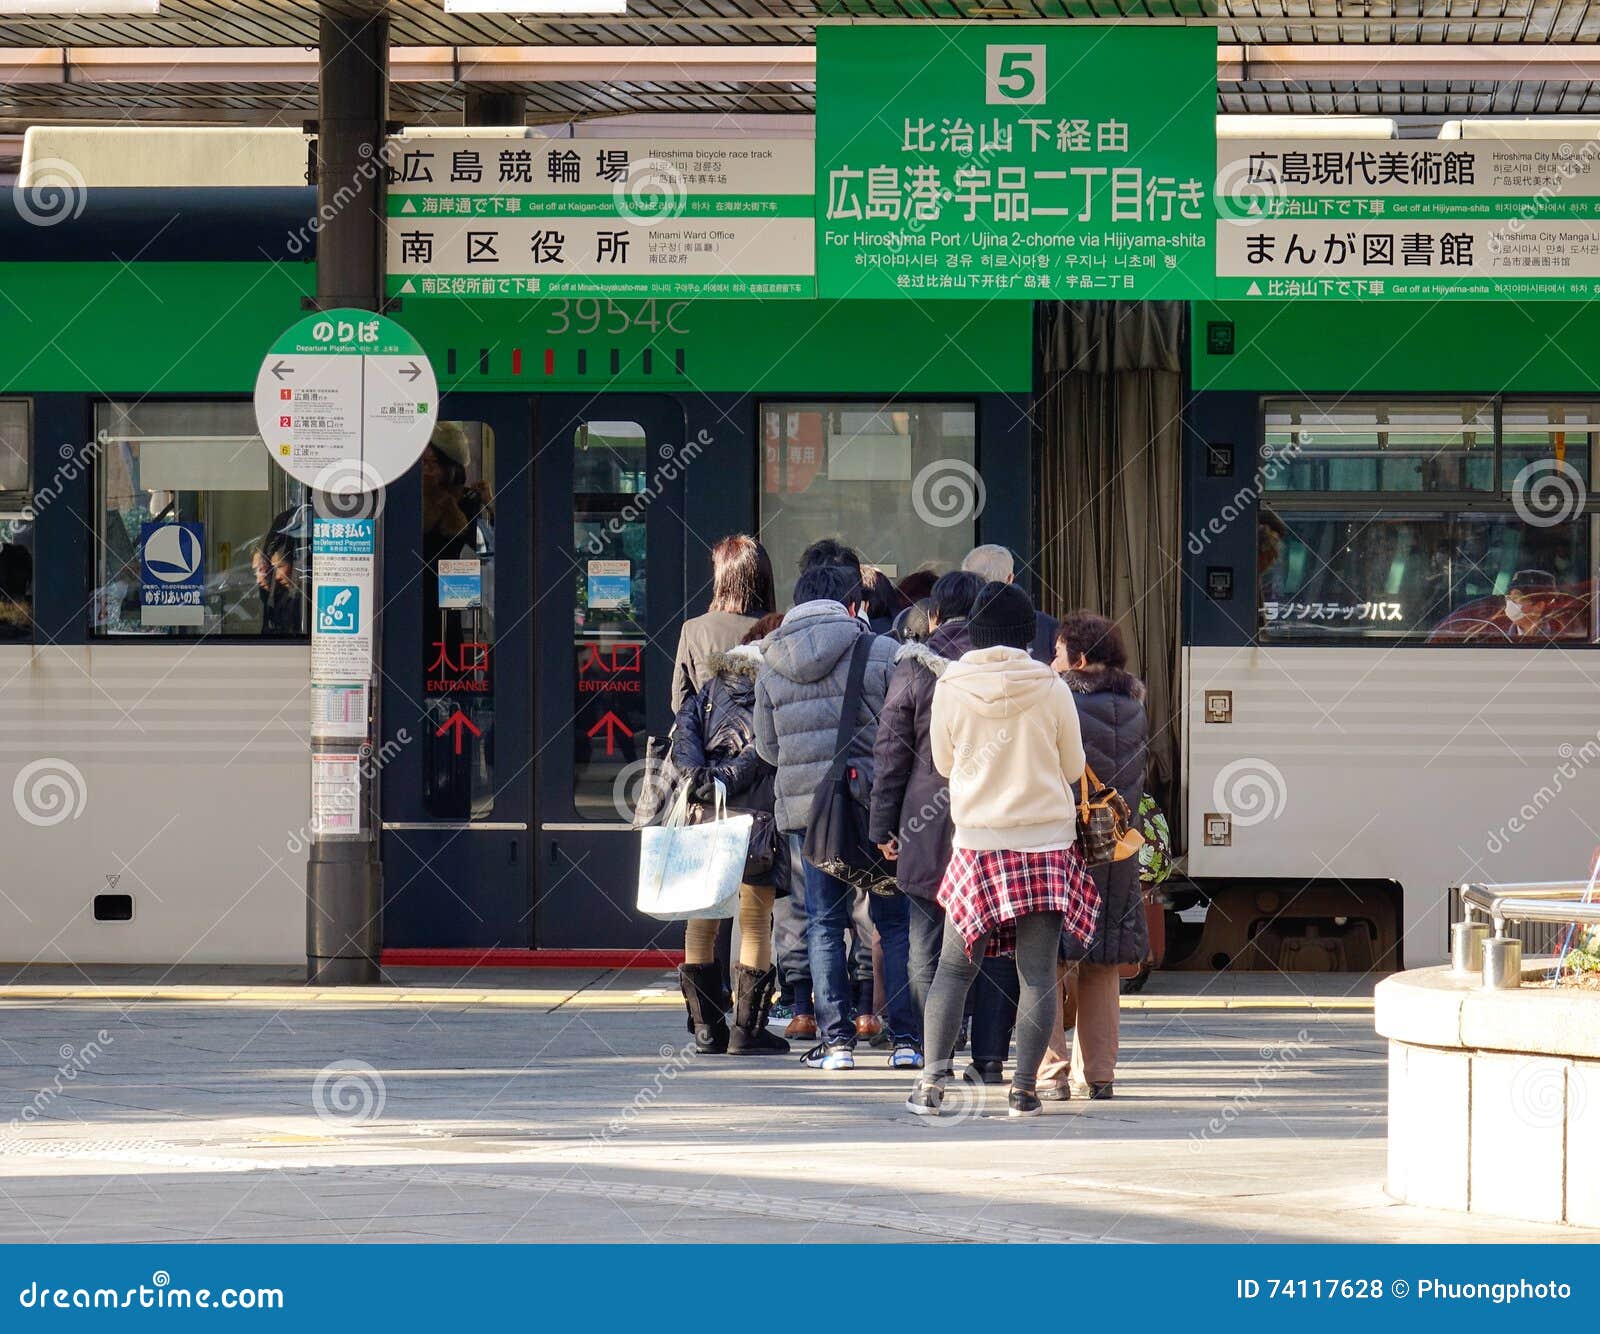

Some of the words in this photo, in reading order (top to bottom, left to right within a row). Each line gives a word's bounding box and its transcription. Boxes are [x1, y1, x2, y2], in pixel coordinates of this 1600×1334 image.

[997, 52, 1035, 99] 5
[902, 117, 1129, 153] 比治山下経由
[648, 150, 693, 159] Hiroshima
[695, 150, 726, 160] bicycle
[729, 151, 748, 159] race
[750, 150, 773, 159] track
[1492, 152, 1533, 161] Hiroshima
[1534, 152, 1550, 163] City
[401, 149, 630, 184] 広島競輪場
[1247, 151, 1475, 185] 広島現代美術館
[422, 197, 521, 214] 海岸通で下車
[528, 202, 544, 211] Get
[546, 202, 557, 211] off
[558, 203, 566, 211] at
[1268, 199, 1385, 216] 比治山下で下車
[1392, 203, 1409, 213] Get
[1410, 203, 1420, 213] off
[1422, 204, 1430, 213] at
[1432, 203, 1490, 215] Hijiyama-shita
[648, 231, 681, 240] Minami
[683, 231, 707, 240] Ward
[709, 231, 735, 240] Office
[825, 231, 849, 246] For
[853, 231, 926, 246] Hiroshima
[931, 231, 961, 246] Port
[971, 231, 1008, 249] Ujina
[1012, 231, 1075, 247] 2-chome
[1079, 232, 1100, 247] via
[1104, 231, 1206, 250] Hijiyama-shita
[1540, 232, 1558, 244] City
[1560, 232, 1589, 244] Manga
[401, 229, 630, 264] 南区役所
[1246, 232, 1474, 266] まんが図書館
[854, 253, 938, 268] 히지야마시타
[946, 253, 973, 268] 경유
[980, 253, 1050, 268] 히로시마항
[1065, 253, 1107, 268] 우지나
[1114, 253, 1156, 268] 니초메
[421, 278, 541, 294] 南区役所前で下車
[1268, 280, 1385, 297] 比治山下で下車
[1392, 284, 1408, 294] Get
[1410, 284, 1420, 294] off
[1422, 285, 1430, 294] at
[1432, 284, 1490, 296] Hijiyama-shita
[312, 320, 380, 343] のりば
[296, 344, 327, 353] Departure
[428, 642, 489, 672] 入口
[580, 642, 641, 673] 入口
[427, 680, 489, 692] ENTRANCE
[579, 680, 641, 692] ENTRANCE
